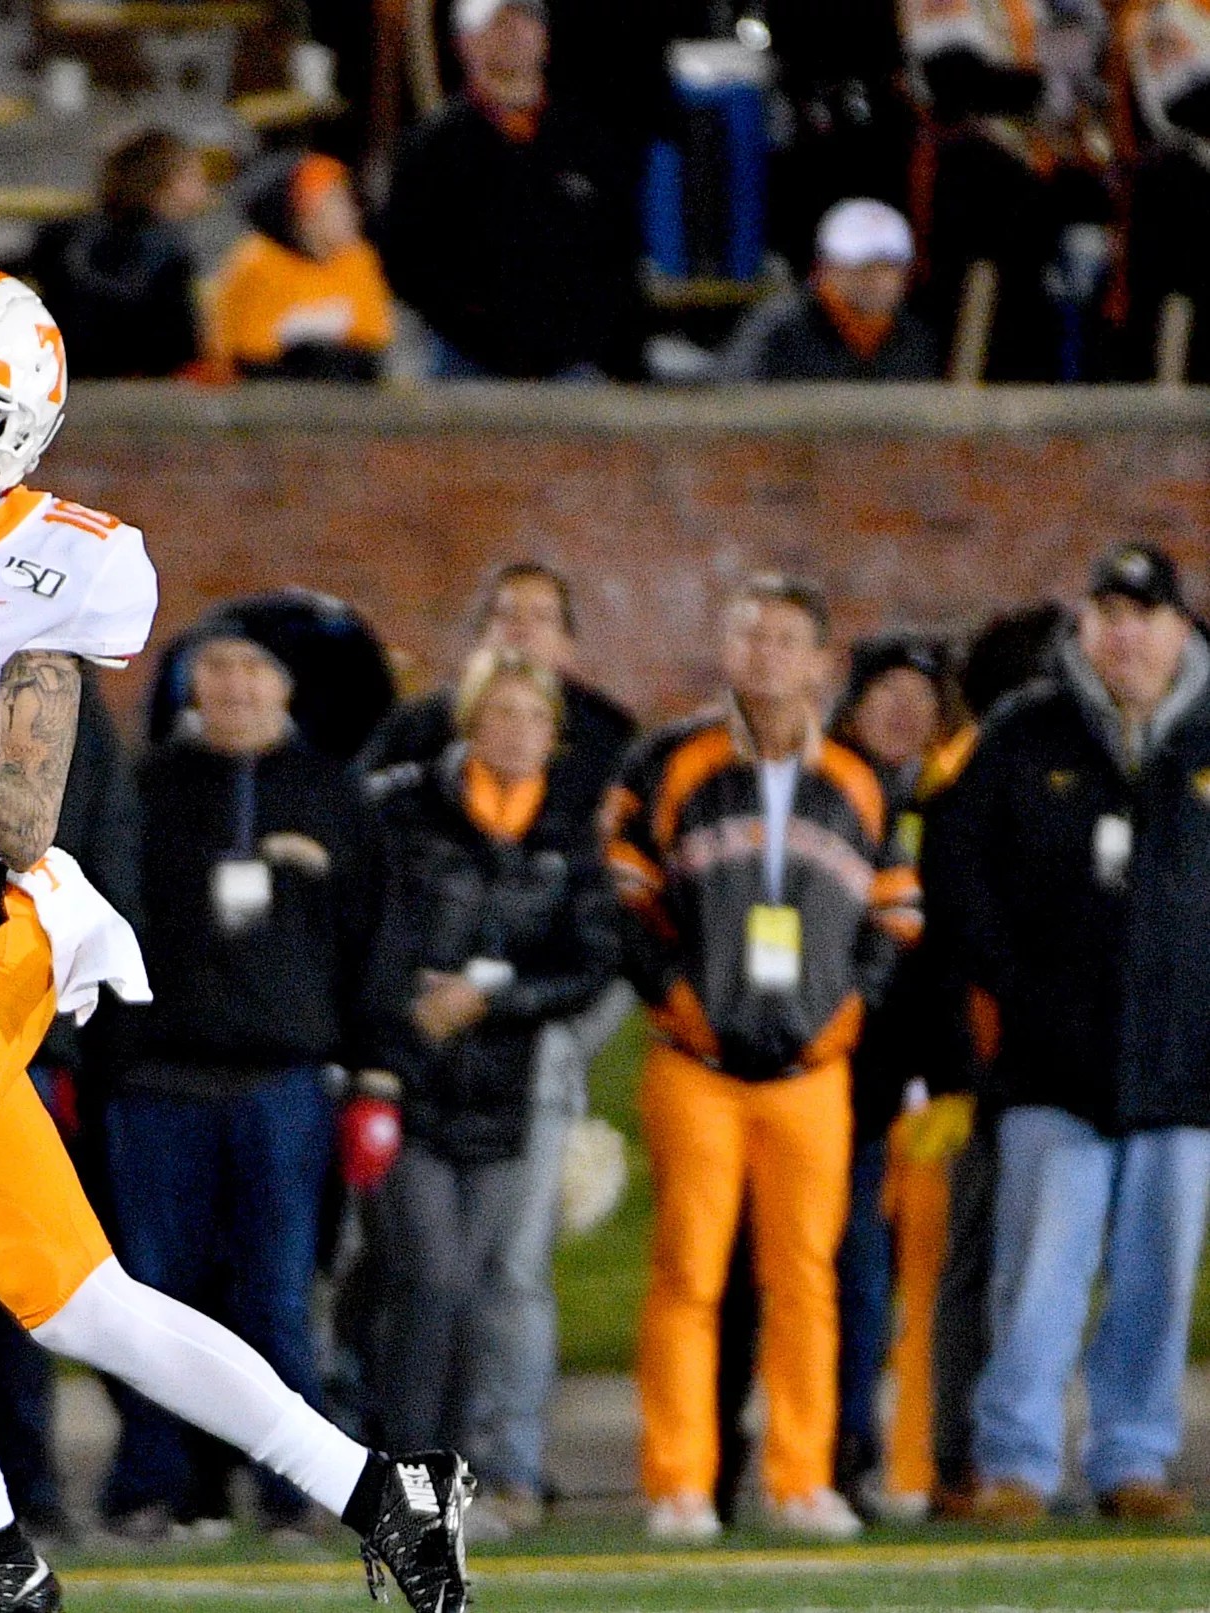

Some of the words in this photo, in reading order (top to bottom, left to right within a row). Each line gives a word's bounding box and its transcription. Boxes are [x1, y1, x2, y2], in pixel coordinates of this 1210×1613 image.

[35, 323, 64, 405] T
[4, 556, 67, 598] 150
[29, 856, 62, 892] T
[396, 1462, 440, 1513] NIKE
